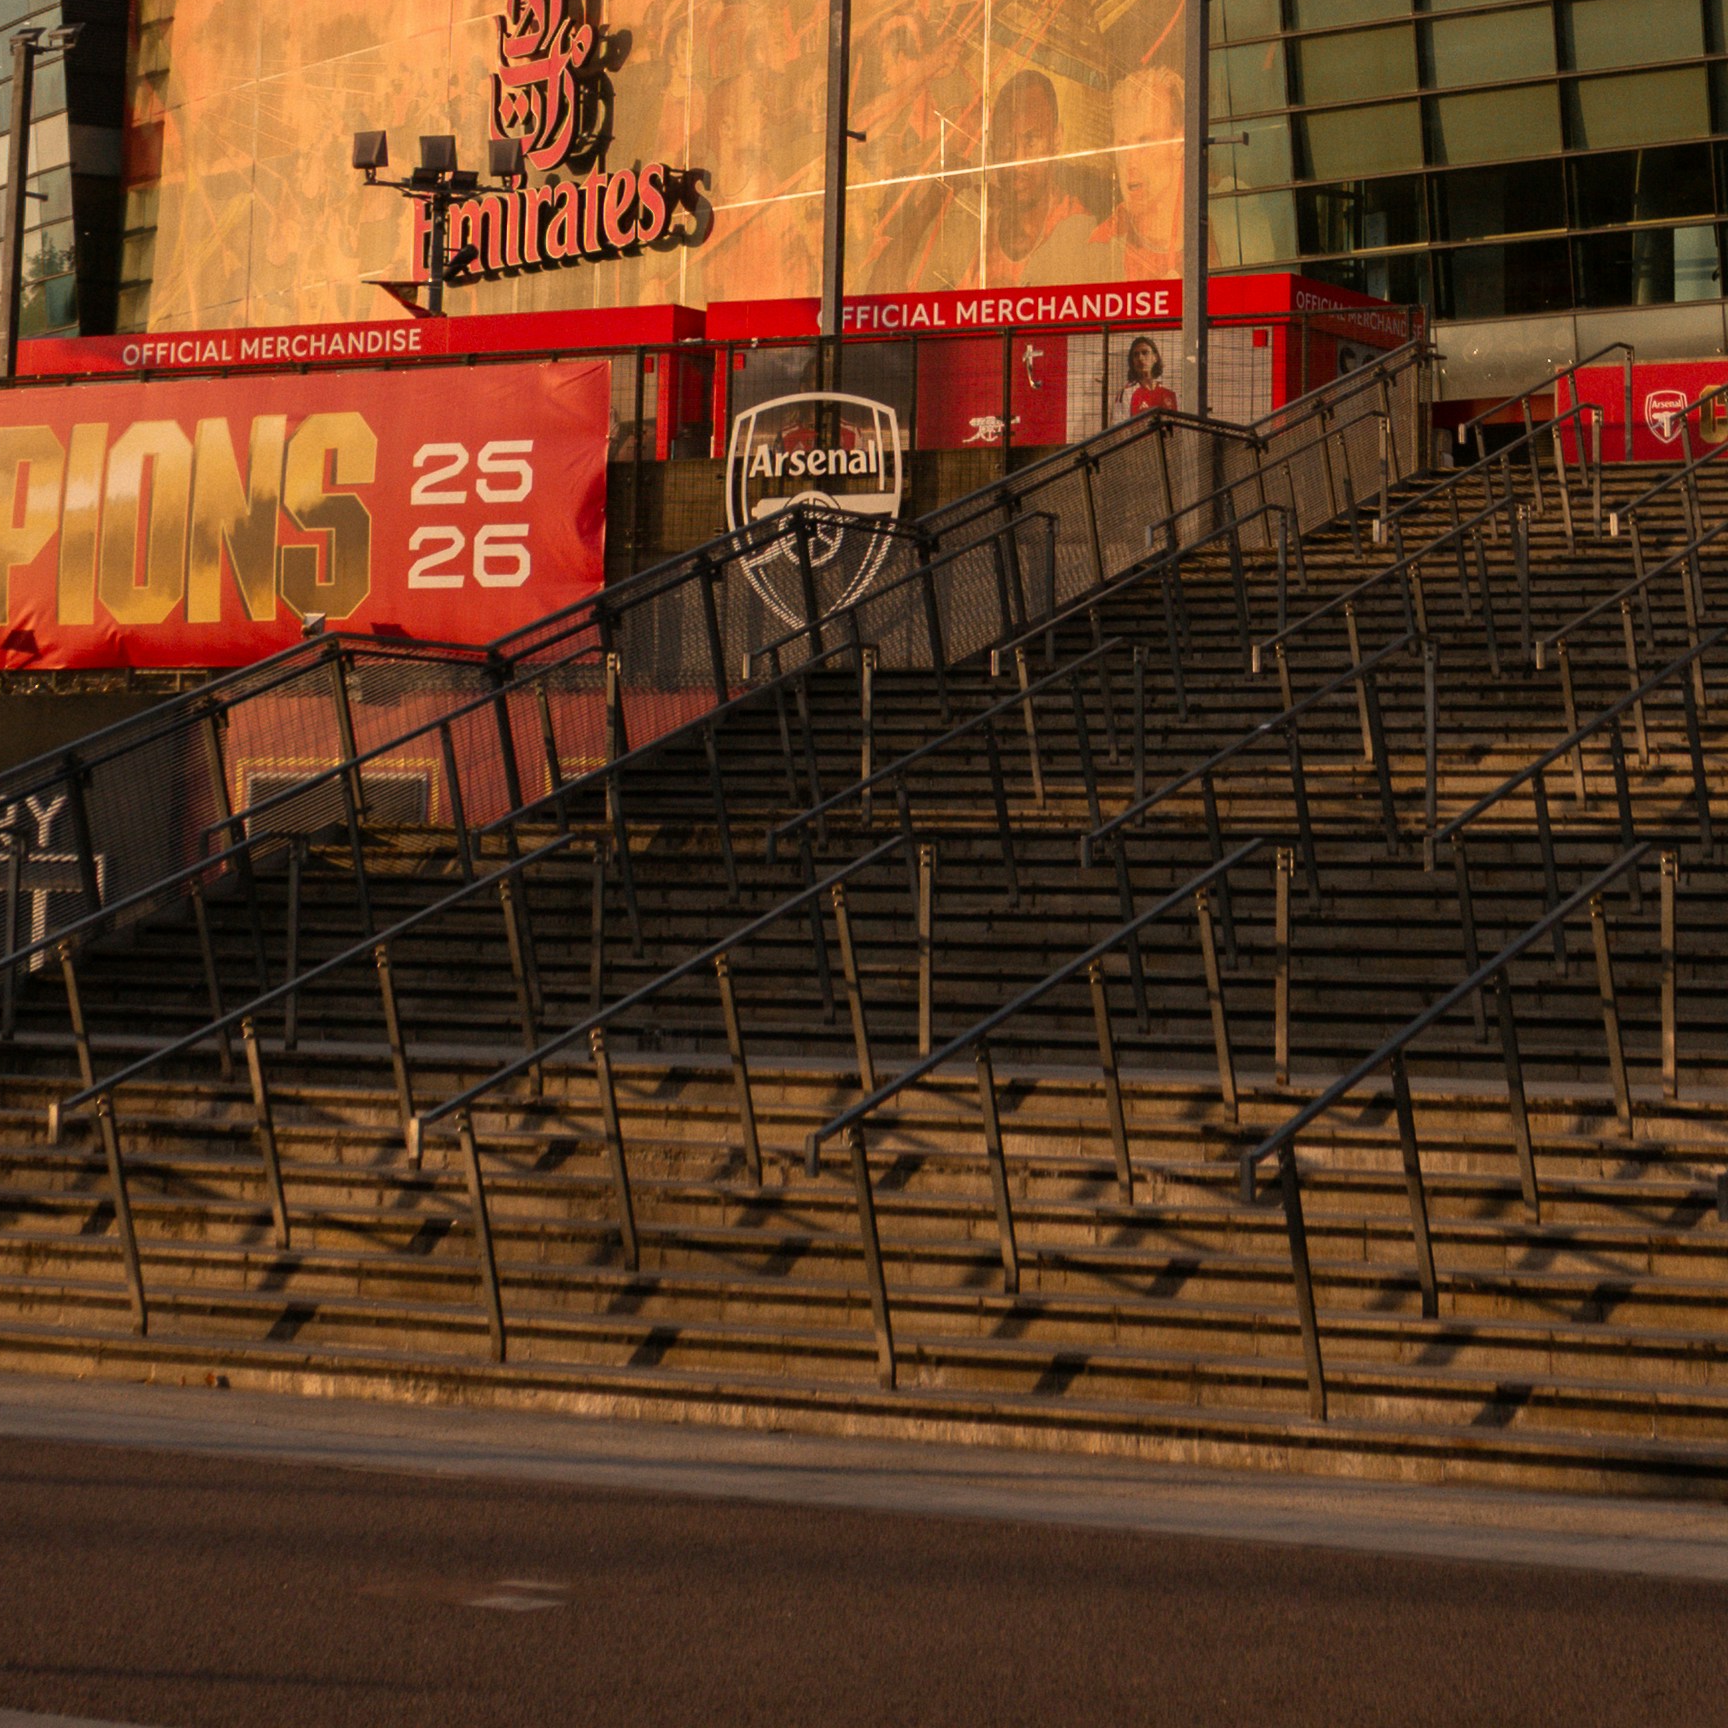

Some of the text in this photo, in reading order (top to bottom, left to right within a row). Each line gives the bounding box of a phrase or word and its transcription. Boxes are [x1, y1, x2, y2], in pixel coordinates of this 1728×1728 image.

[412, 162, 668, 282] Emirates
[816, 290, 1170, 330] FFICIAL MERCHANDISE
[1348, 311, 1423, 339] MERCHANDSE
[123, 328, 422, 367] OFFICIAL MERCHANDISE
[410, 439, 534, 506] 25
[749, 439, 879, 478] Arsenal
[408, 523, 532, 589] 26
